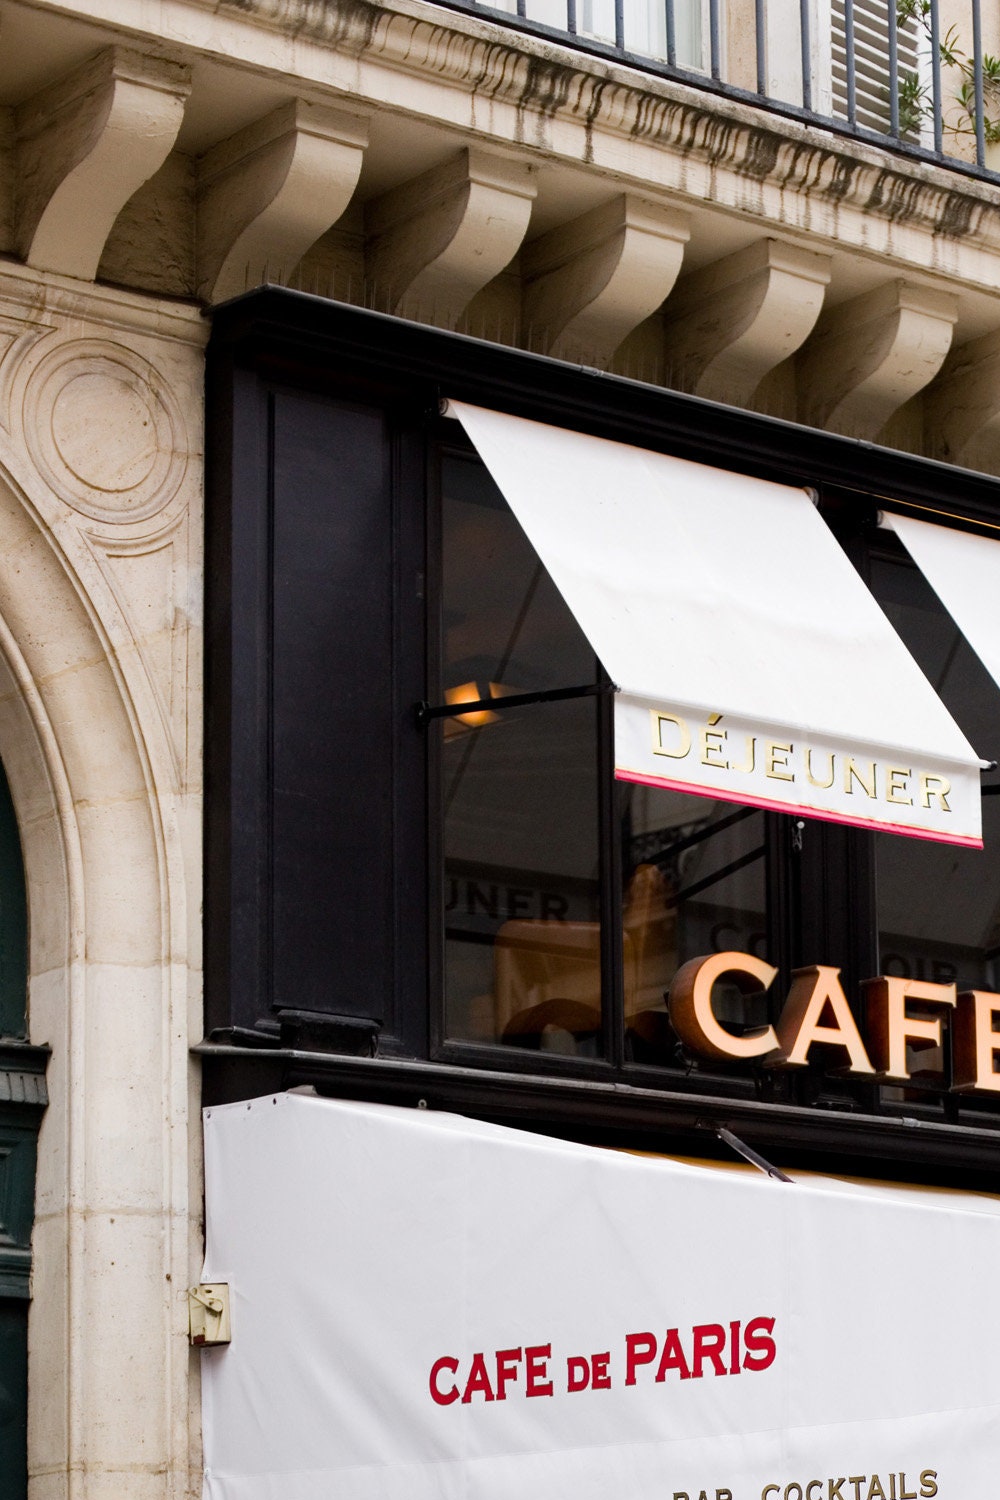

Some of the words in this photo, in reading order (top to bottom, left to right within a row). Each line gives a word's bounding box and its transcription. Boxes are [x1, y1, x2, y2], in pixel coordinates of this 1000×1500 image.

[649, 709, 953, 813] DÉJEUNER
[429, 1344, 553, 1406] CAFE
[566, 1351, 611, 1391] DE
[625, 1316, 777, 1386] PARIS
